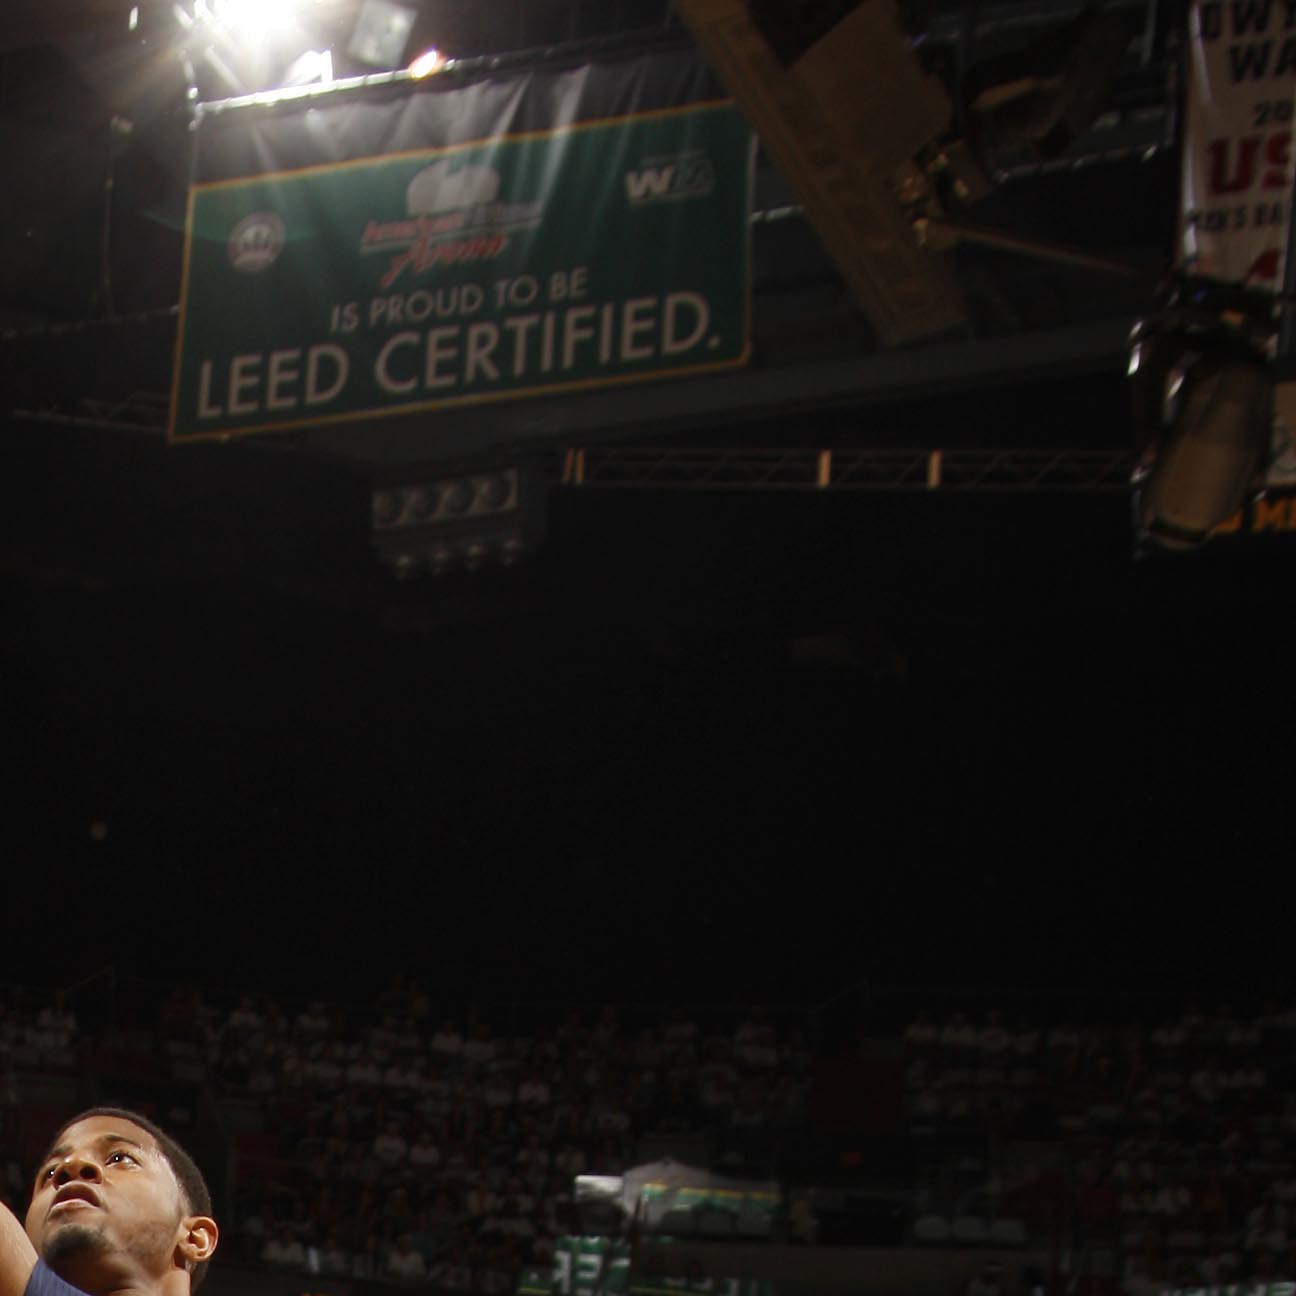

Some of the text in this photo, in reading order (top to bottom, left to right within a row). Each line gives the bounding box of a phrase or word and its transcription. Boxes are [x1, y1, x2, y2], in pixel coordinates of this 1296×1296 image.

[330, 266, 590, 335] IS PROUD TO BE
[195, 290, 725, 421] LEED CERTIFIED.
